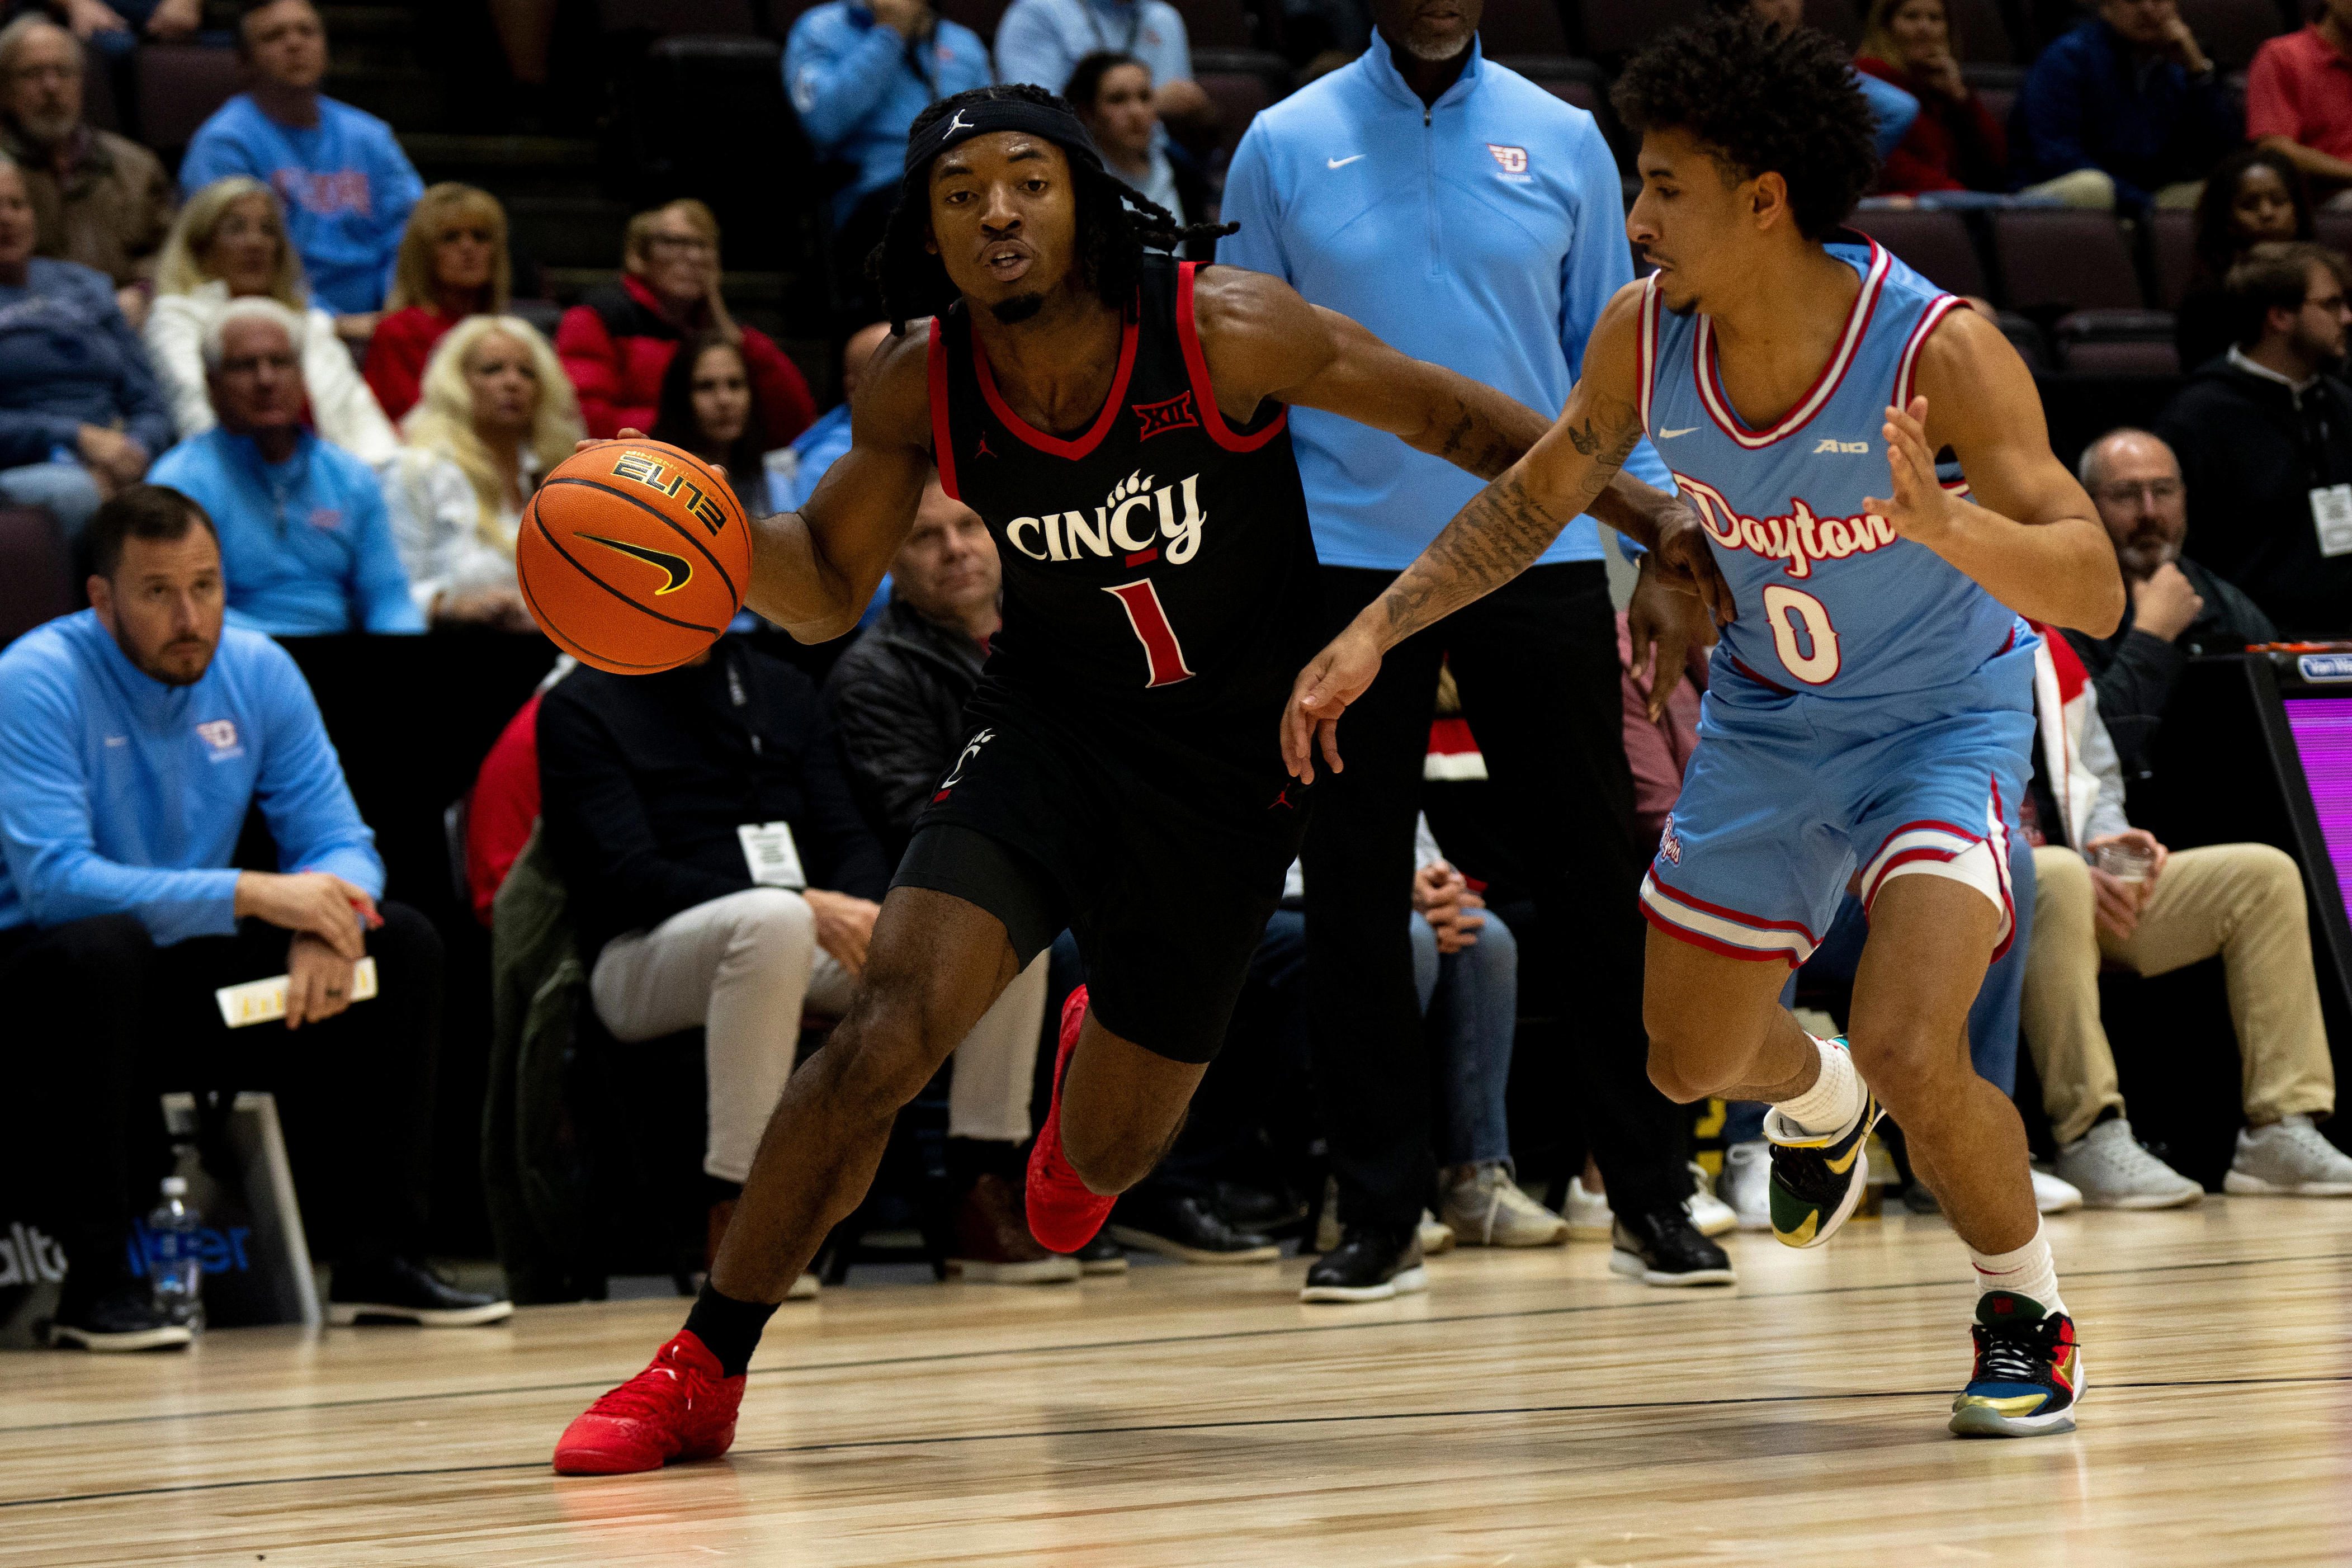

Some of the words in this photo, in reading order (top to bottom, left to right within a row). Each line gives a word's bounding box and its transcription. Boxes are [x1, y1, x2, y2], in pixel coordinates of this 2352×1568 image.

[610, 454, 727, 537] ELITE
[1813, 439, 1869, 454] A10
[1672, 470, 1899, 579] Dayton
[1100, 578, 1197, 688] 1
[1763, 583, 1841, 686] 0
